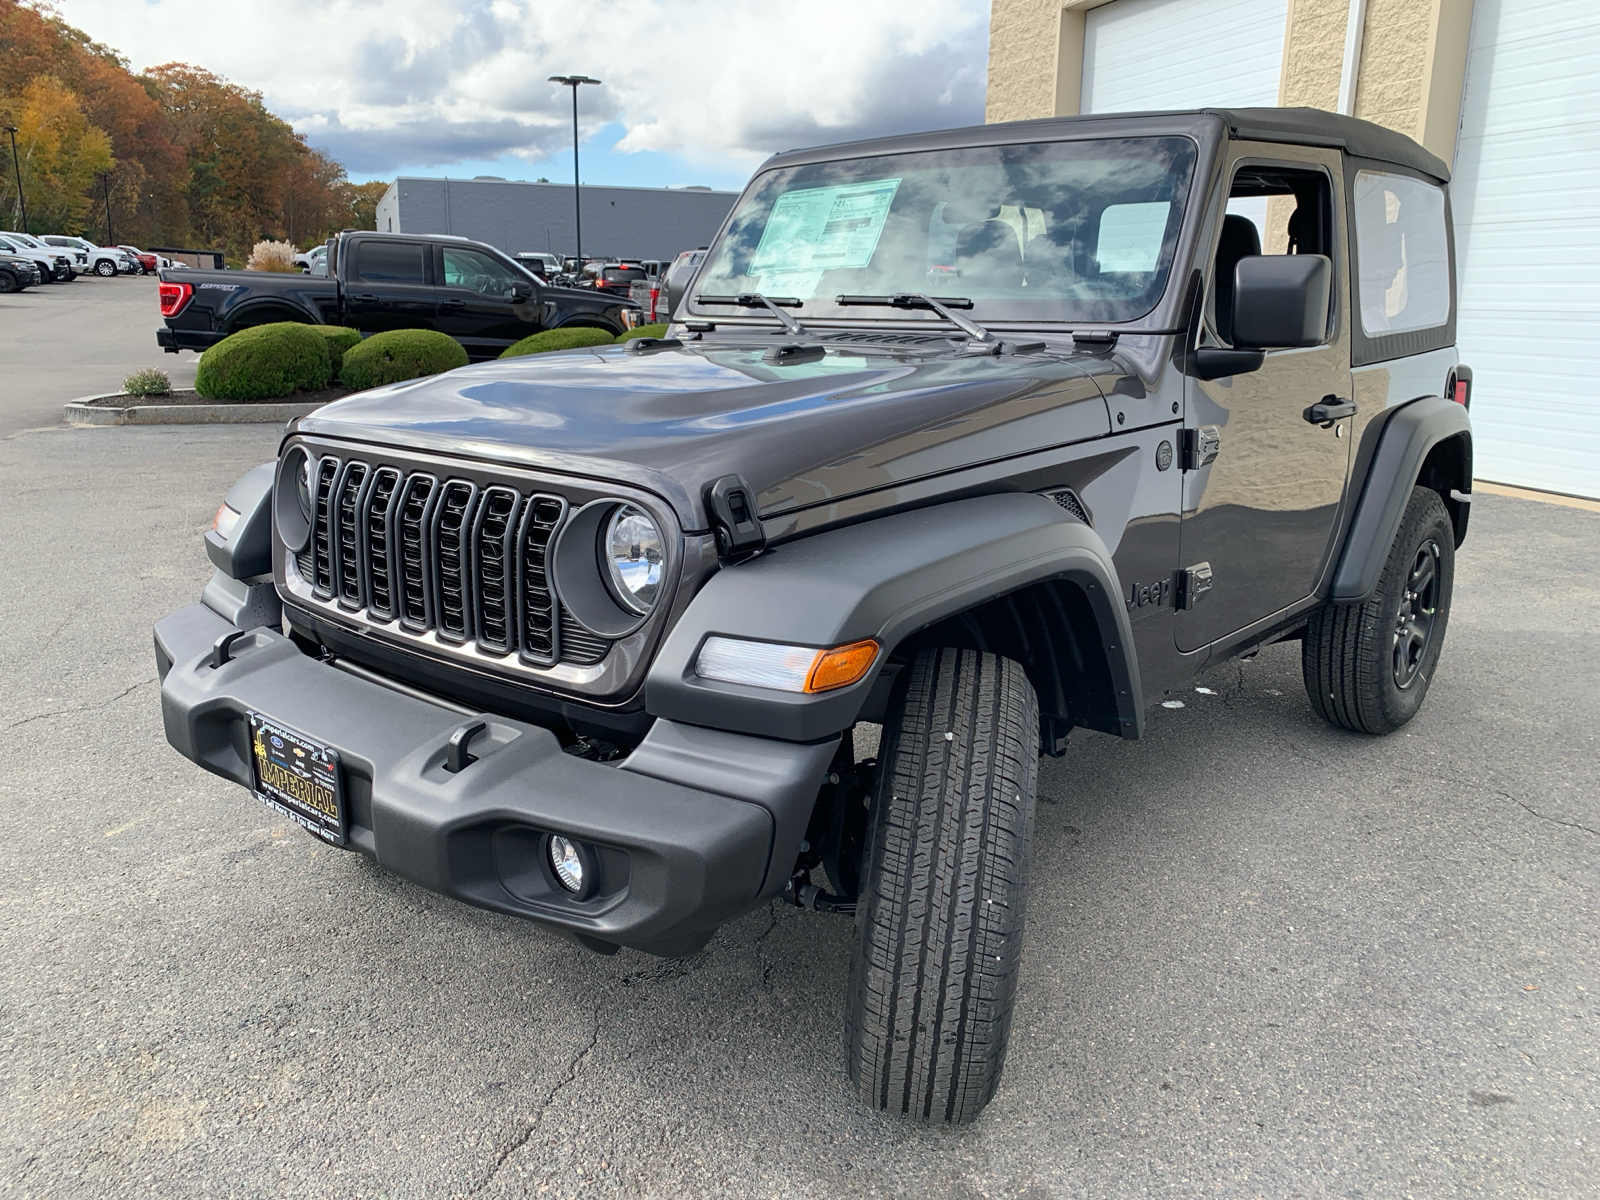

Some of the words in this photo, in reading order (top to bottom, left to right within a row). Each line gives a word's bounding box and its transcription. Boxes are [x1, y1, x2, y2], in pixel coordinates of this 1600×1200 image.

[1125, 578, 1170, 612] Jeep
[259, 757, 338, 819] IMPERIAL
[319, 779, 336, 792] TOYOTA
[261, 781, 340, 828] www.imperialcars.com
[289, 812, 296, 821] So
[297, 815, 307, 827] You
[320, 827, 335, 842] More
